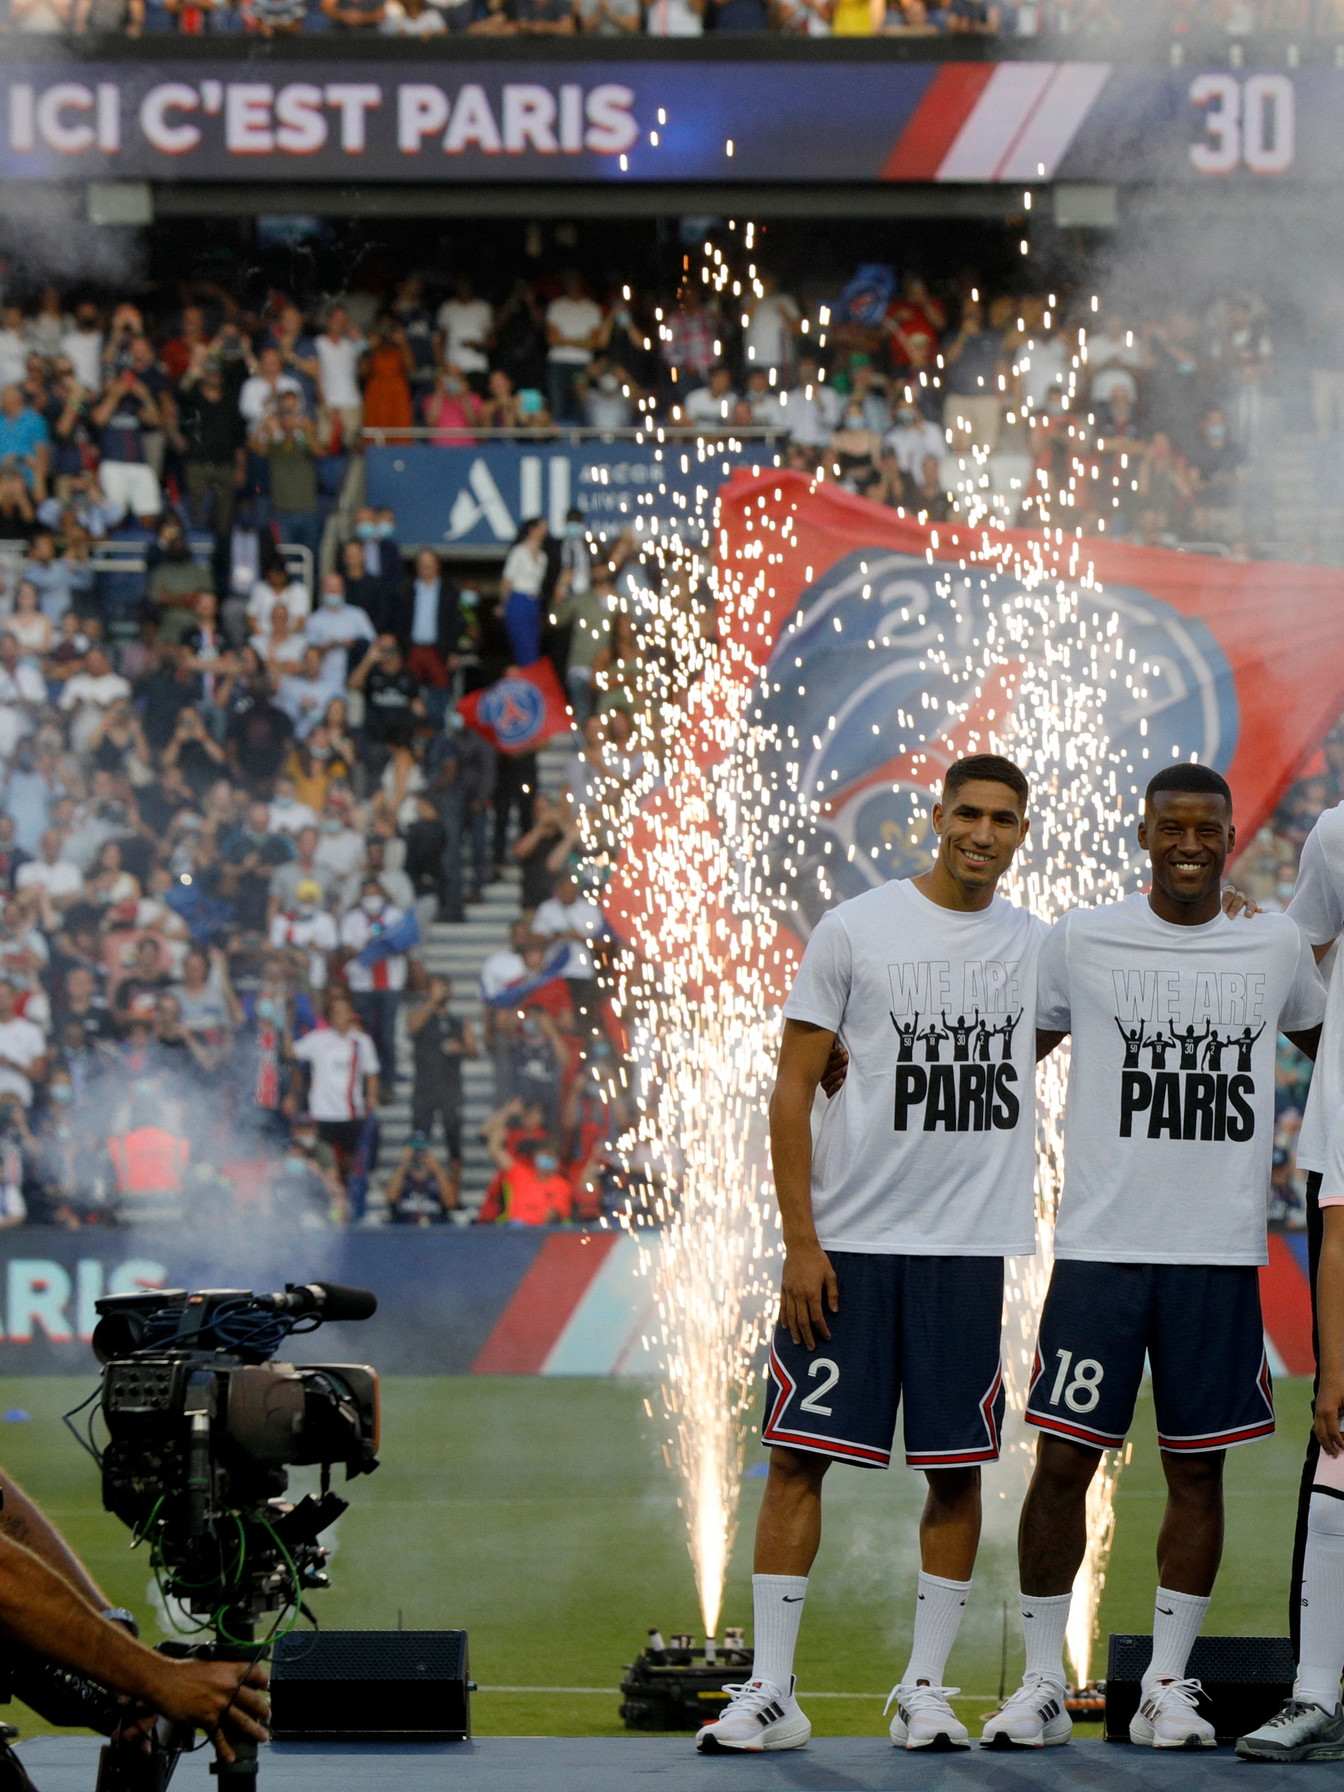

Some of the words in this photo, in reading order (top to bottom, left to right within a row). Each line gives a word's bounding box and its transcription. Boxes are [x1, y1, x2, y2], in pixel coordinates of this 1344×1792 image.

[9, 82, 121, 155] ICI
[140, 81, 382, 155] C'EST
[399, 83, 640, 155] PARIS
[1188, 73, 1296, 175] 30
[888, 961, 952, 1016] WE
[962, 960, 1021, 1015] ARE
[1112, 969, 1181, 1024] WE
[1192, 971, 1266, 1027] ARE
[903, 1037, 912, 1047] 50
[956, 1034, 966, 1046] 30
[1129, 1044, 1138, 1053] 50
[1184, 1043, 1194, 1055] 30
[1241, 1043, 1247, 1054] 4
[894, 1062, 1020, 1132] PARIS
[1119, 1071, 1256, 1143] PARIS
[800, 1357, 841, 1417] 2
[1048, 1348, 1105, 1414] 18
